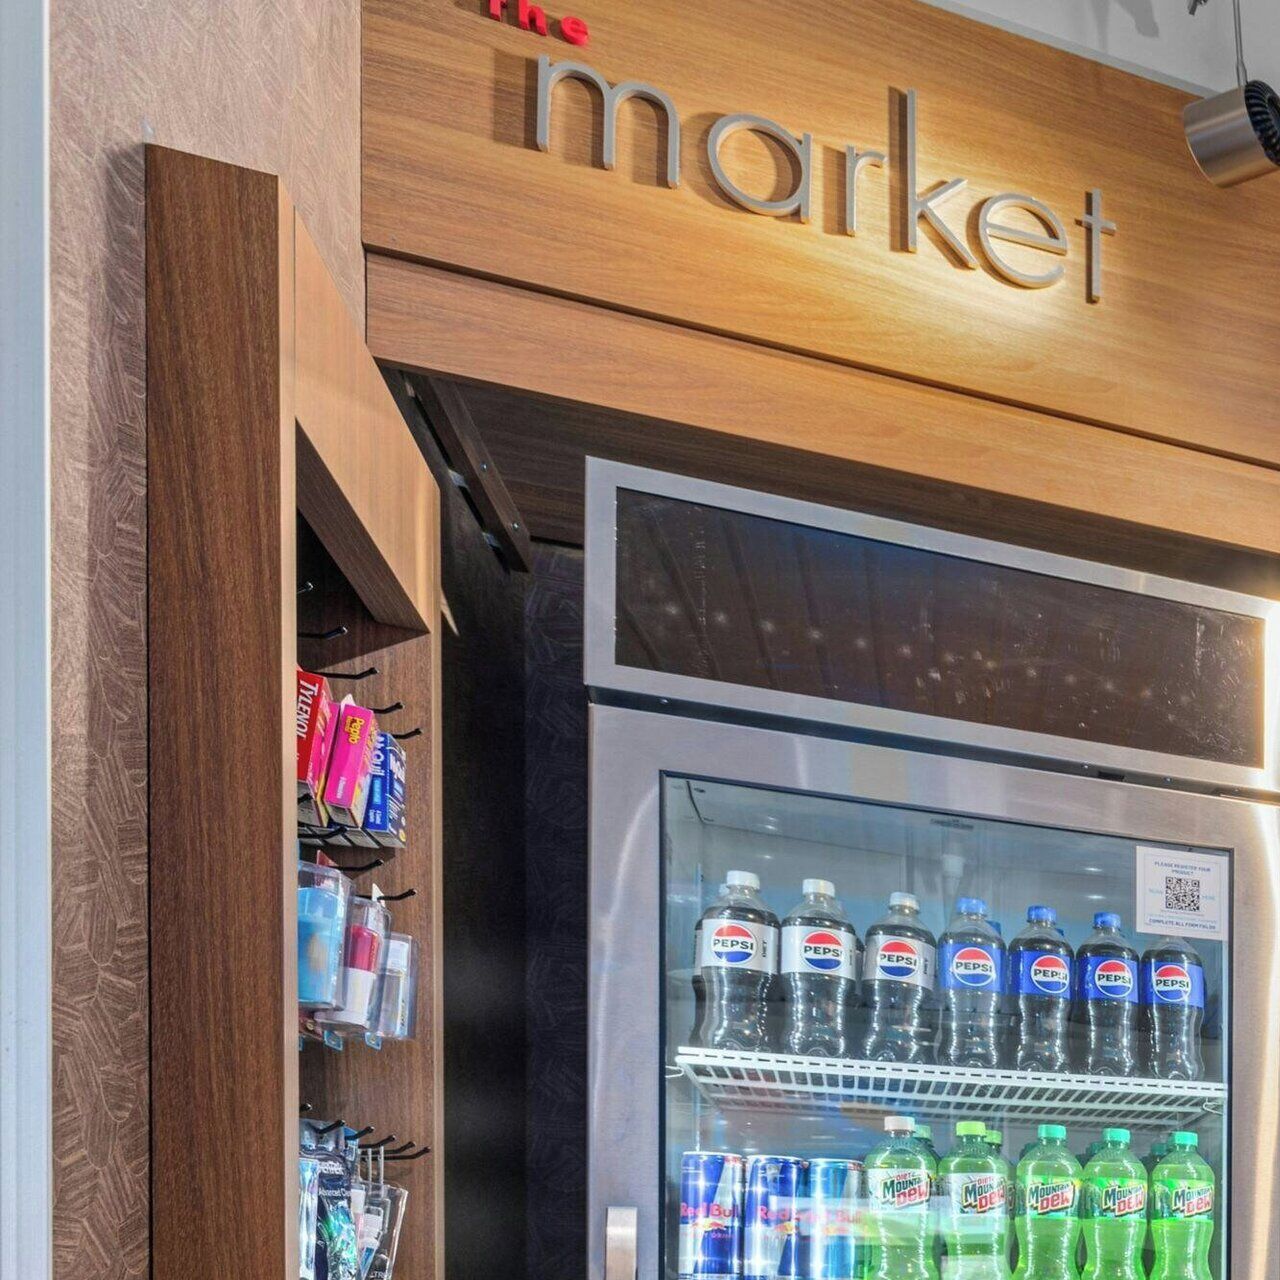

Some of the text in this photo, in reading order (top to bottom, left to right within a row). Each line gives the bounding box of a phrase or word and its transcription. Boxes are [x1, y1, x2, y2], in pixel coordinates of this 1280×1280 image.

[537, 54, 1117, 304] market
[713, 938, 754, 951] PEPSI
[879, 953, 918, 966] PEPSI
[955, 962, 993, 973] PEPSI
[1033, 968, 1068, 981] PEPSI
[1097, 973, 1131, 985] PEPSI
[1155, 978, 1189, 988] PEPSI
